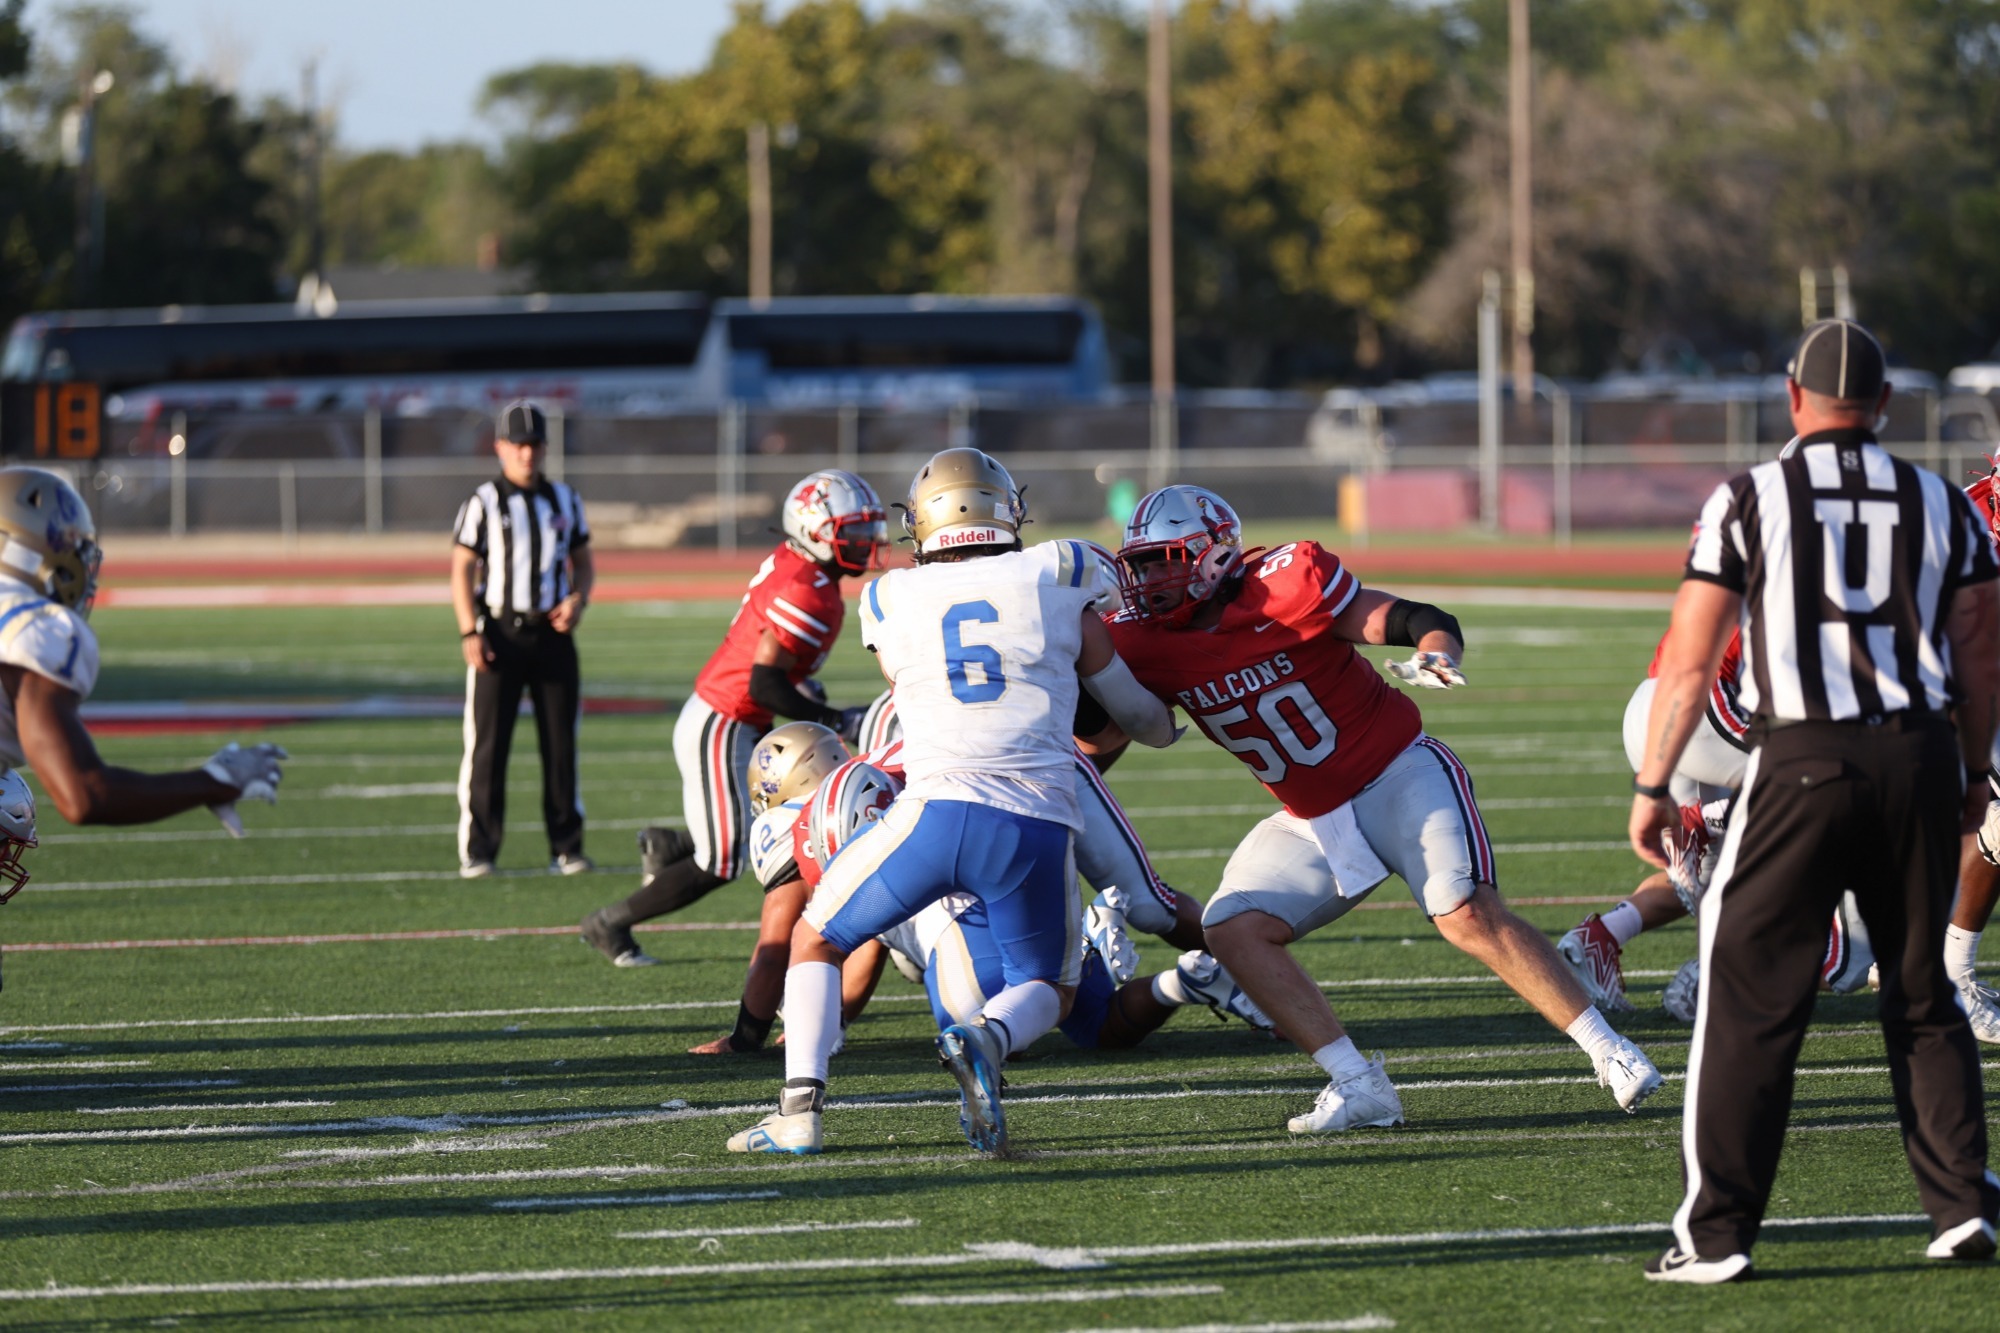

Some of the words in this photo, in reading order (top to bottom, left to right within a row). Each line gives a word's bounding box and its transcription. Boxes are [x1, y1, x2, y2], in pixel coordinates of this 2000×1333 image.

[35, 382, 100, 458] 18
[939, 529, 996, 547] Riddell
[1259, 542, 1298, 579] 50
[1814, 499, 1900, 613] U
[813, 569, 830, 588] 7
[59, 634, 80, 679] 1
[940, 597, 1010, 704] 6
[1177, 652, 1295, 711] FALCONS
[1199, 681, 1339, 784] 50
